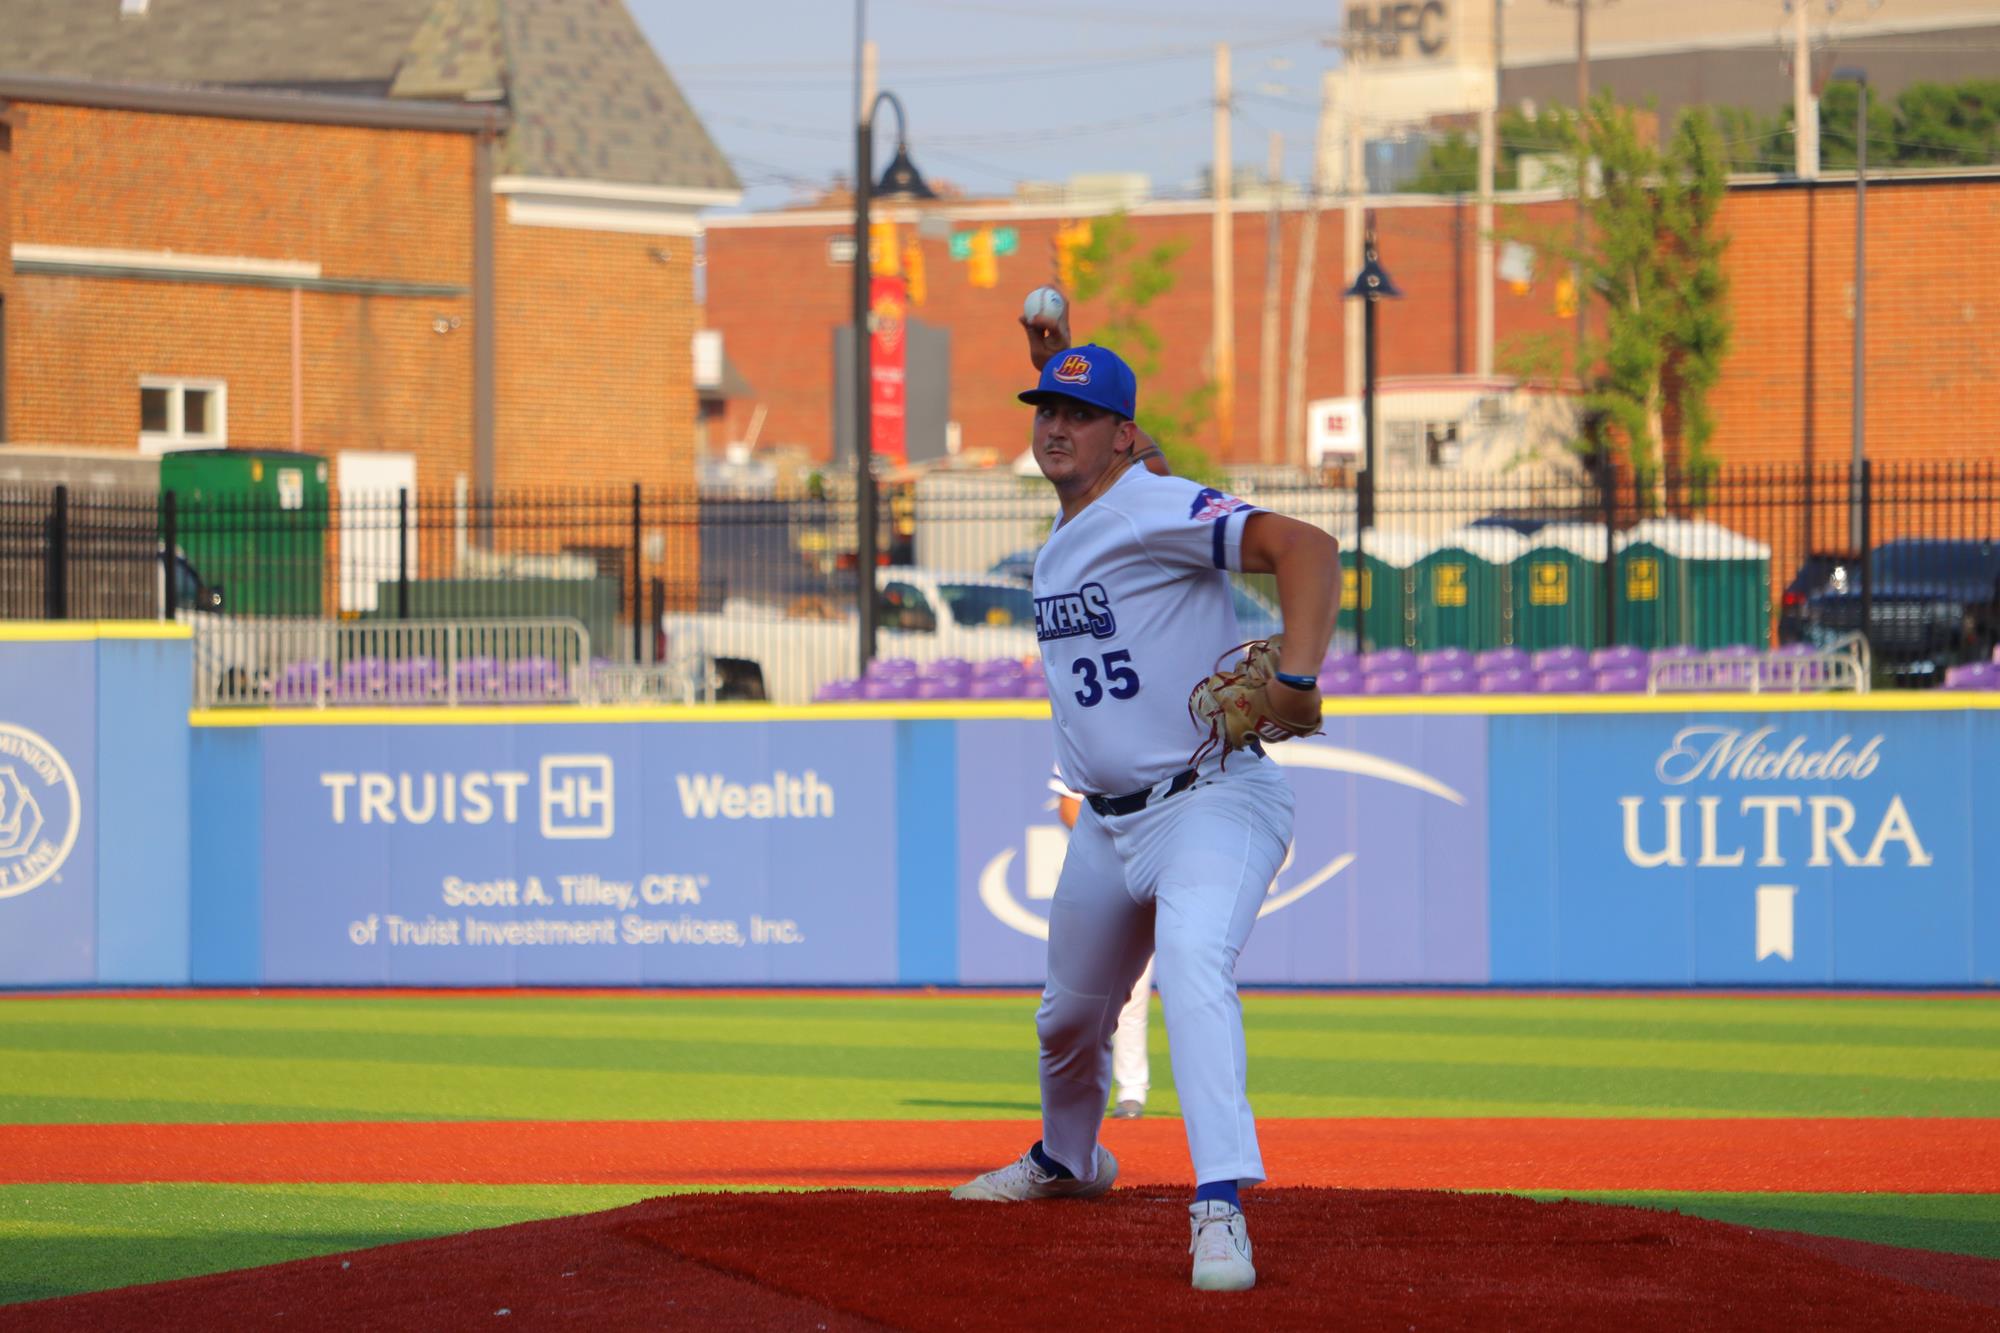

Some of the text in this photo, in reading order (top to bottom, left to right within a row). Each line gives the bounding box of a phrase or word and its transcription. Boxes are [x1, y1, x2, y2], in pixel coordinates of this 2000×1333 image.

[1071, 648, 1140, 708] 35
[1656, 724, 1885, 785] Michelob
[320, 770, 835, 824] TRUIST Wealth
[1618, 795, 1934, 868] ULTRA
[443, 875, 519, 907] Scott
[523, 876, 554, 906] A.
[558, 874, 639, 911] Tilley,
[348, 913, 806, 949] of Truist Investment Services, Inc.
